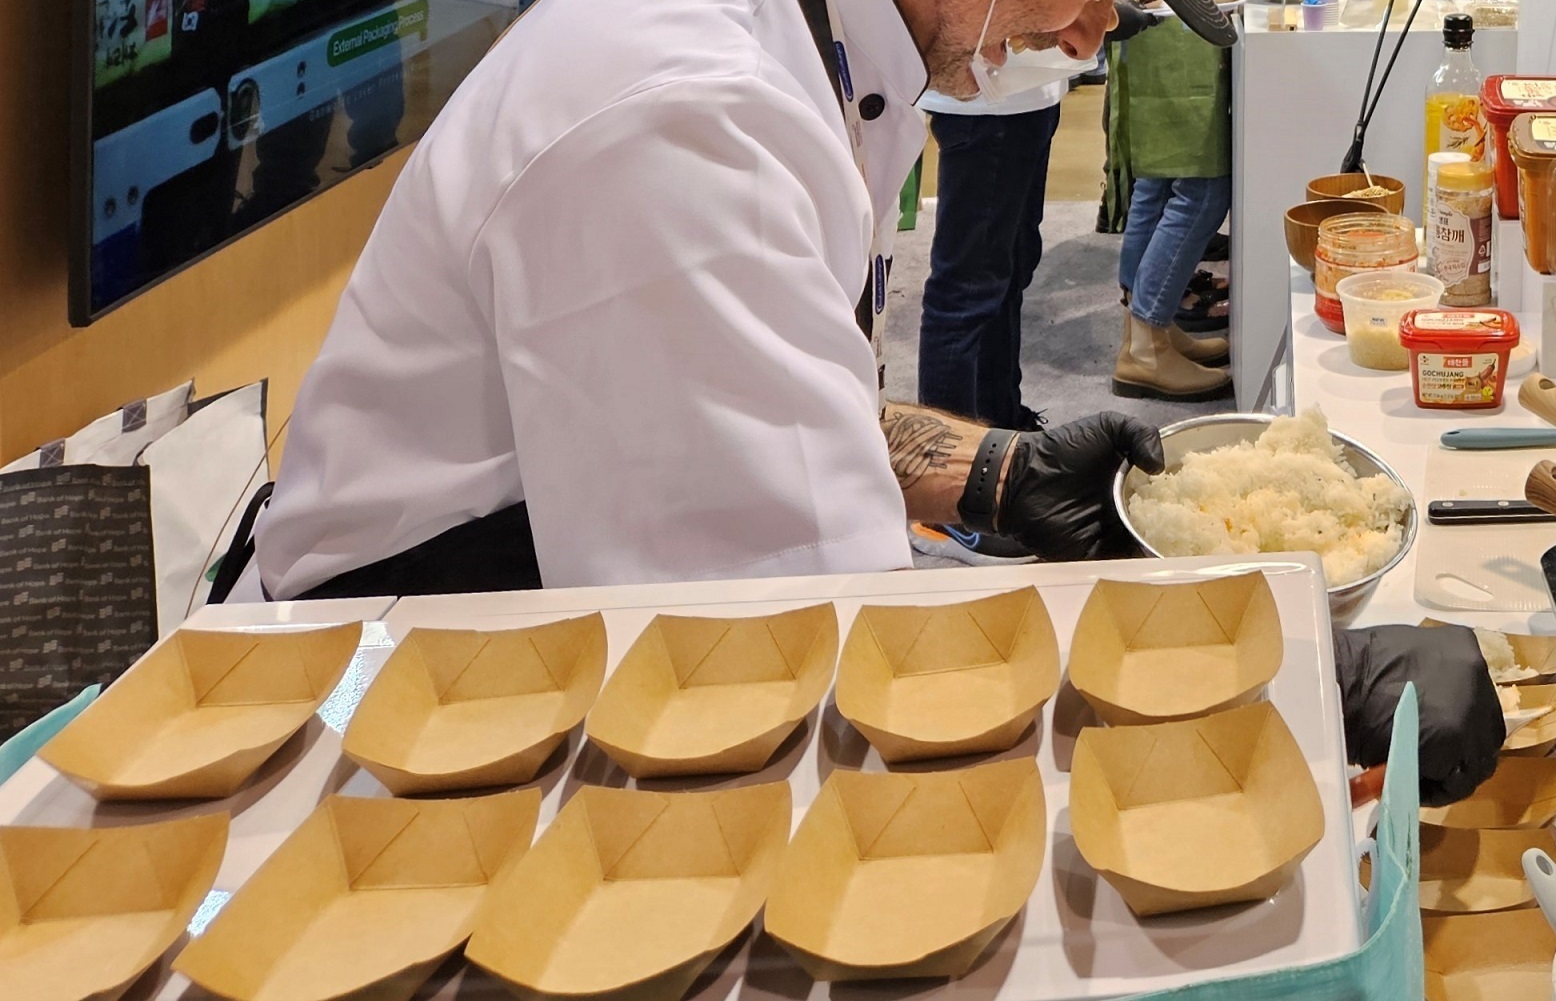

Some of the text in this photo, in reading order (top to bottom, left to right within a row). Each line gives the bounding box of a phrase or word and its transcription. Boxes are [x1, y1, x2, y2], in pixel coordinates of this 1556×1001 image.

[333, 9, 424, 56] External Packaging Process
[1422, 369, 1464, 378] GOCHUJANG
